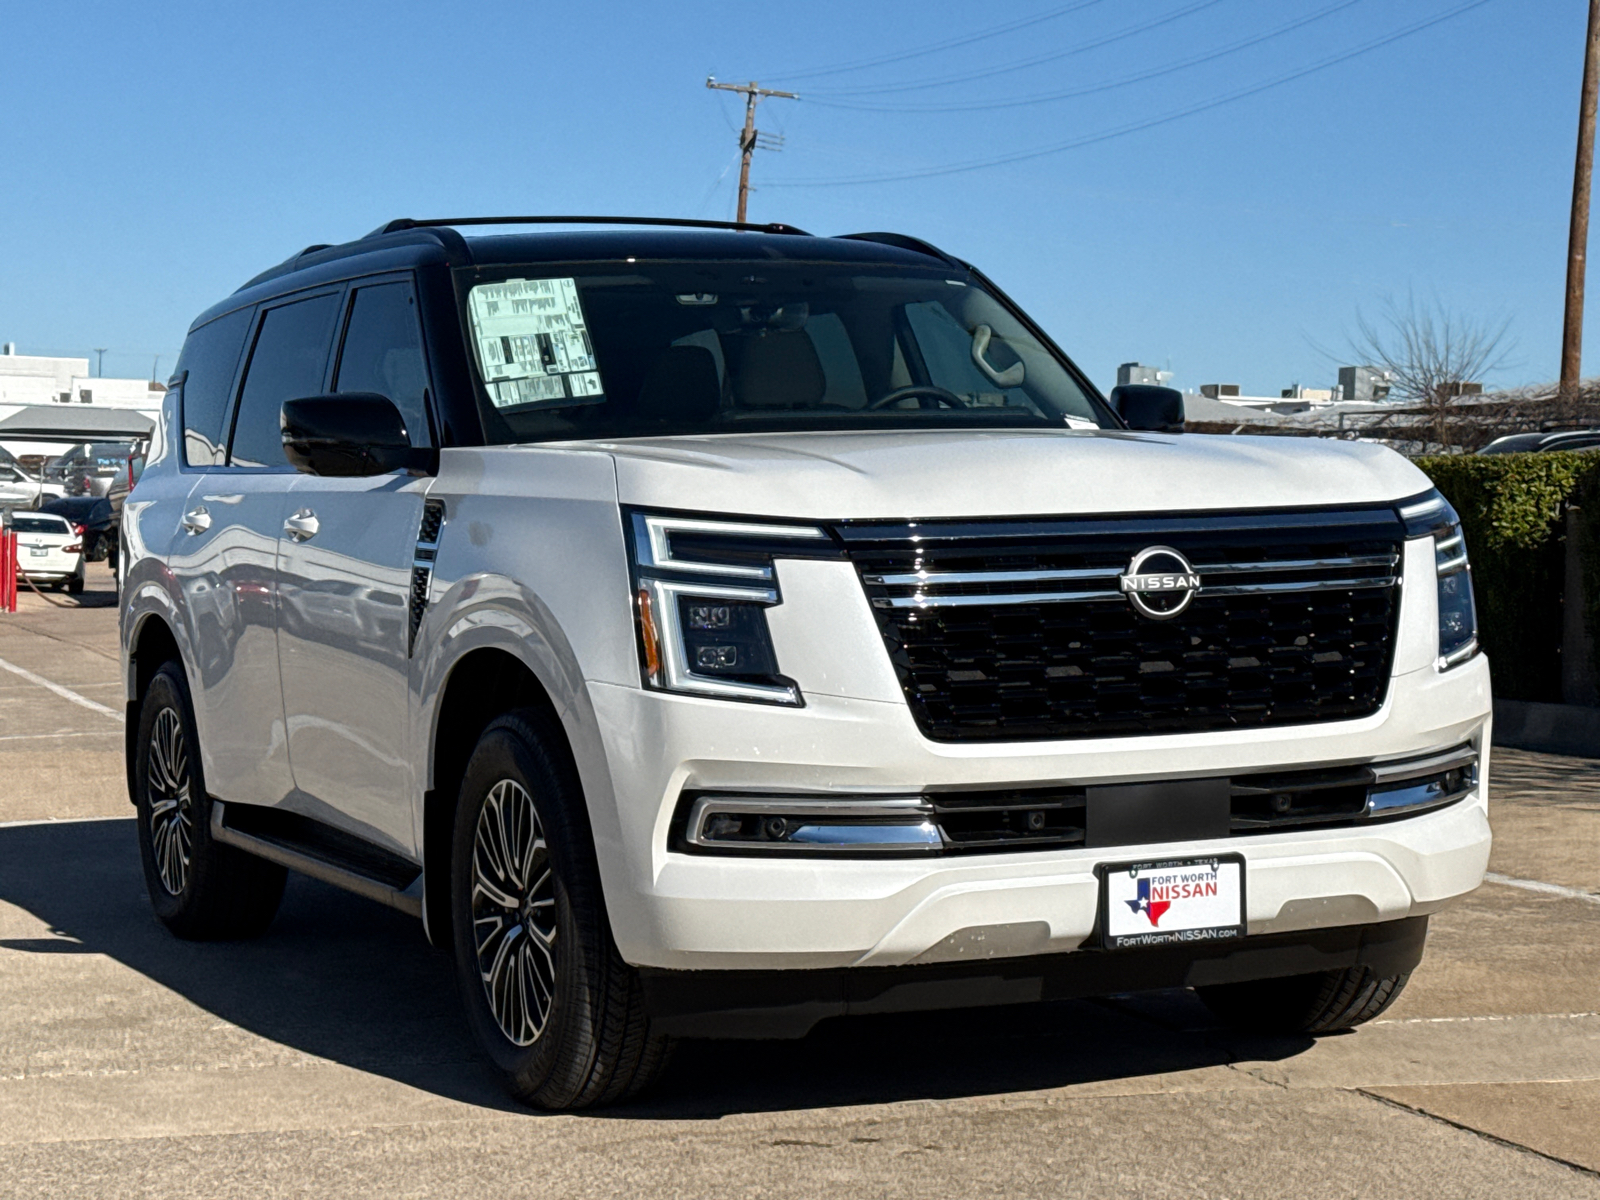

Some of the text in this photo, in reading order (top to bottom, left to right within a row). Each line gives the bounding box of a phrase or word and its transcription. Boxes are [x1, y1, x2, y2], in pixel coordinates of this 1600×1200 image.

[1123, 576, 1200, 590] NISSAN
[1155, 860, 1183, 868] WORTH
[1194, 857, 1218, 865] TEXAS
[1151, 872, 1217, 886] FORT WORTH
[1152, 882, 1217, 900] NISSAN
